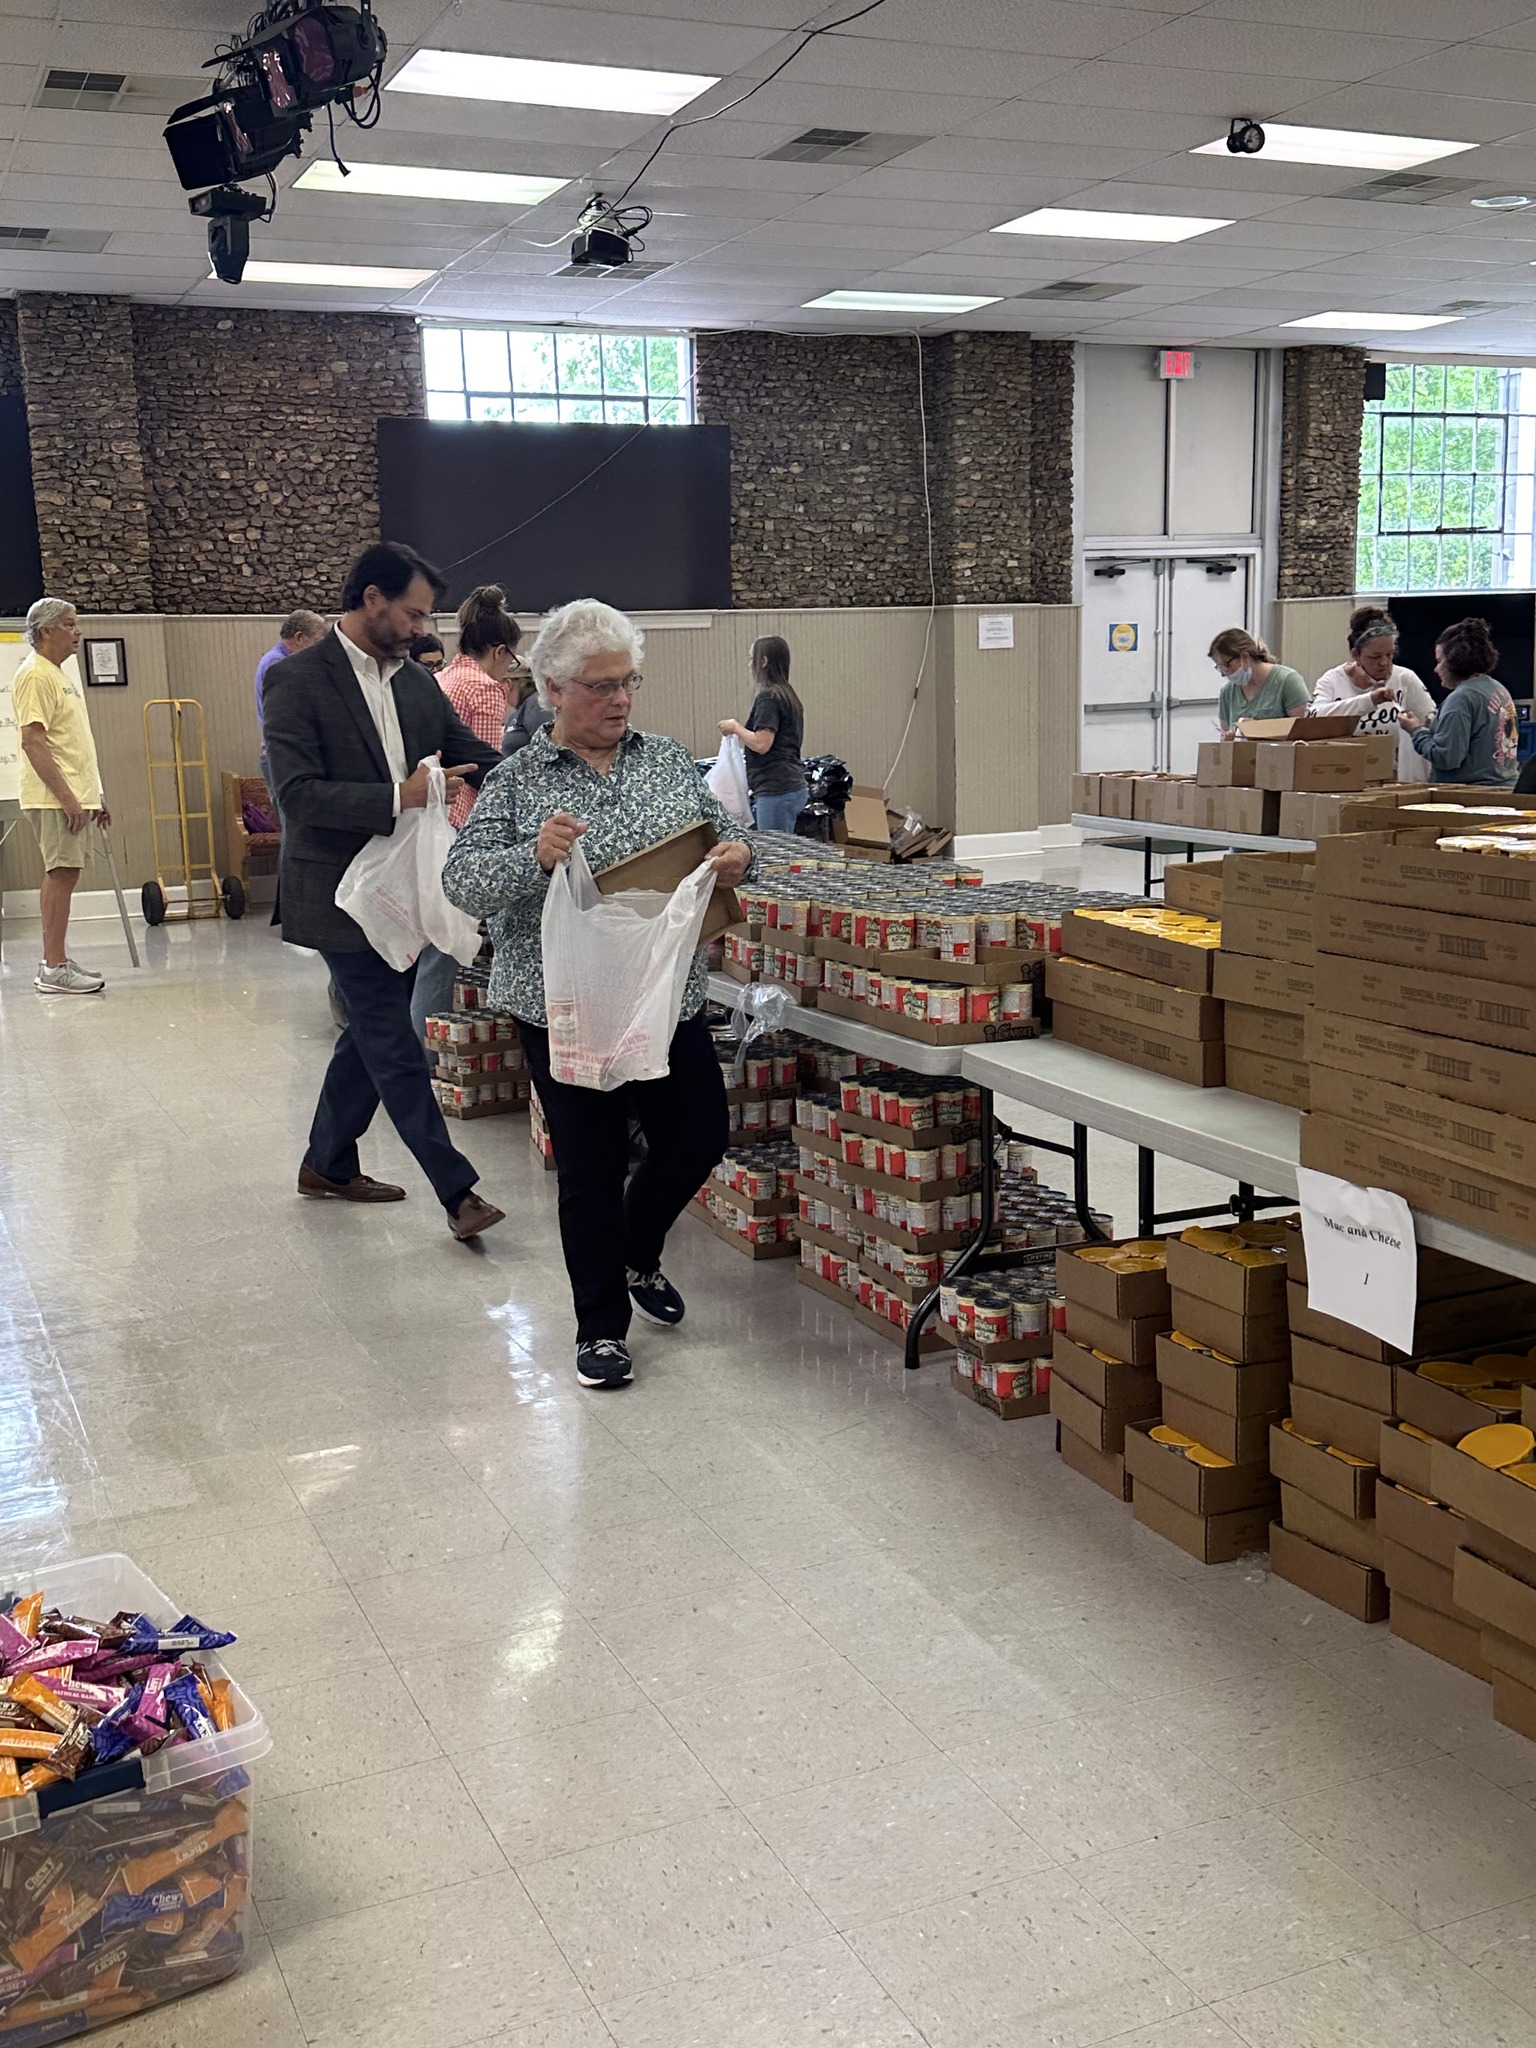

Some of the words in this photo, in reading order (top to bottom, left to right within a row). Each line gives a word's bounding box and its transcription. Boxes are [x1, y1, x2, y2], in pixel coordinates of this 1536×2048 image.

[1166, 352, 1191, 376] EXIT
[1323, 1216, 1345, 1234] Mac
[1347, 1224, 1368, 1239] and
[1368, 1229, 1402, 1250] Cheese
[24, 1857, 55, 1891] Chewy
